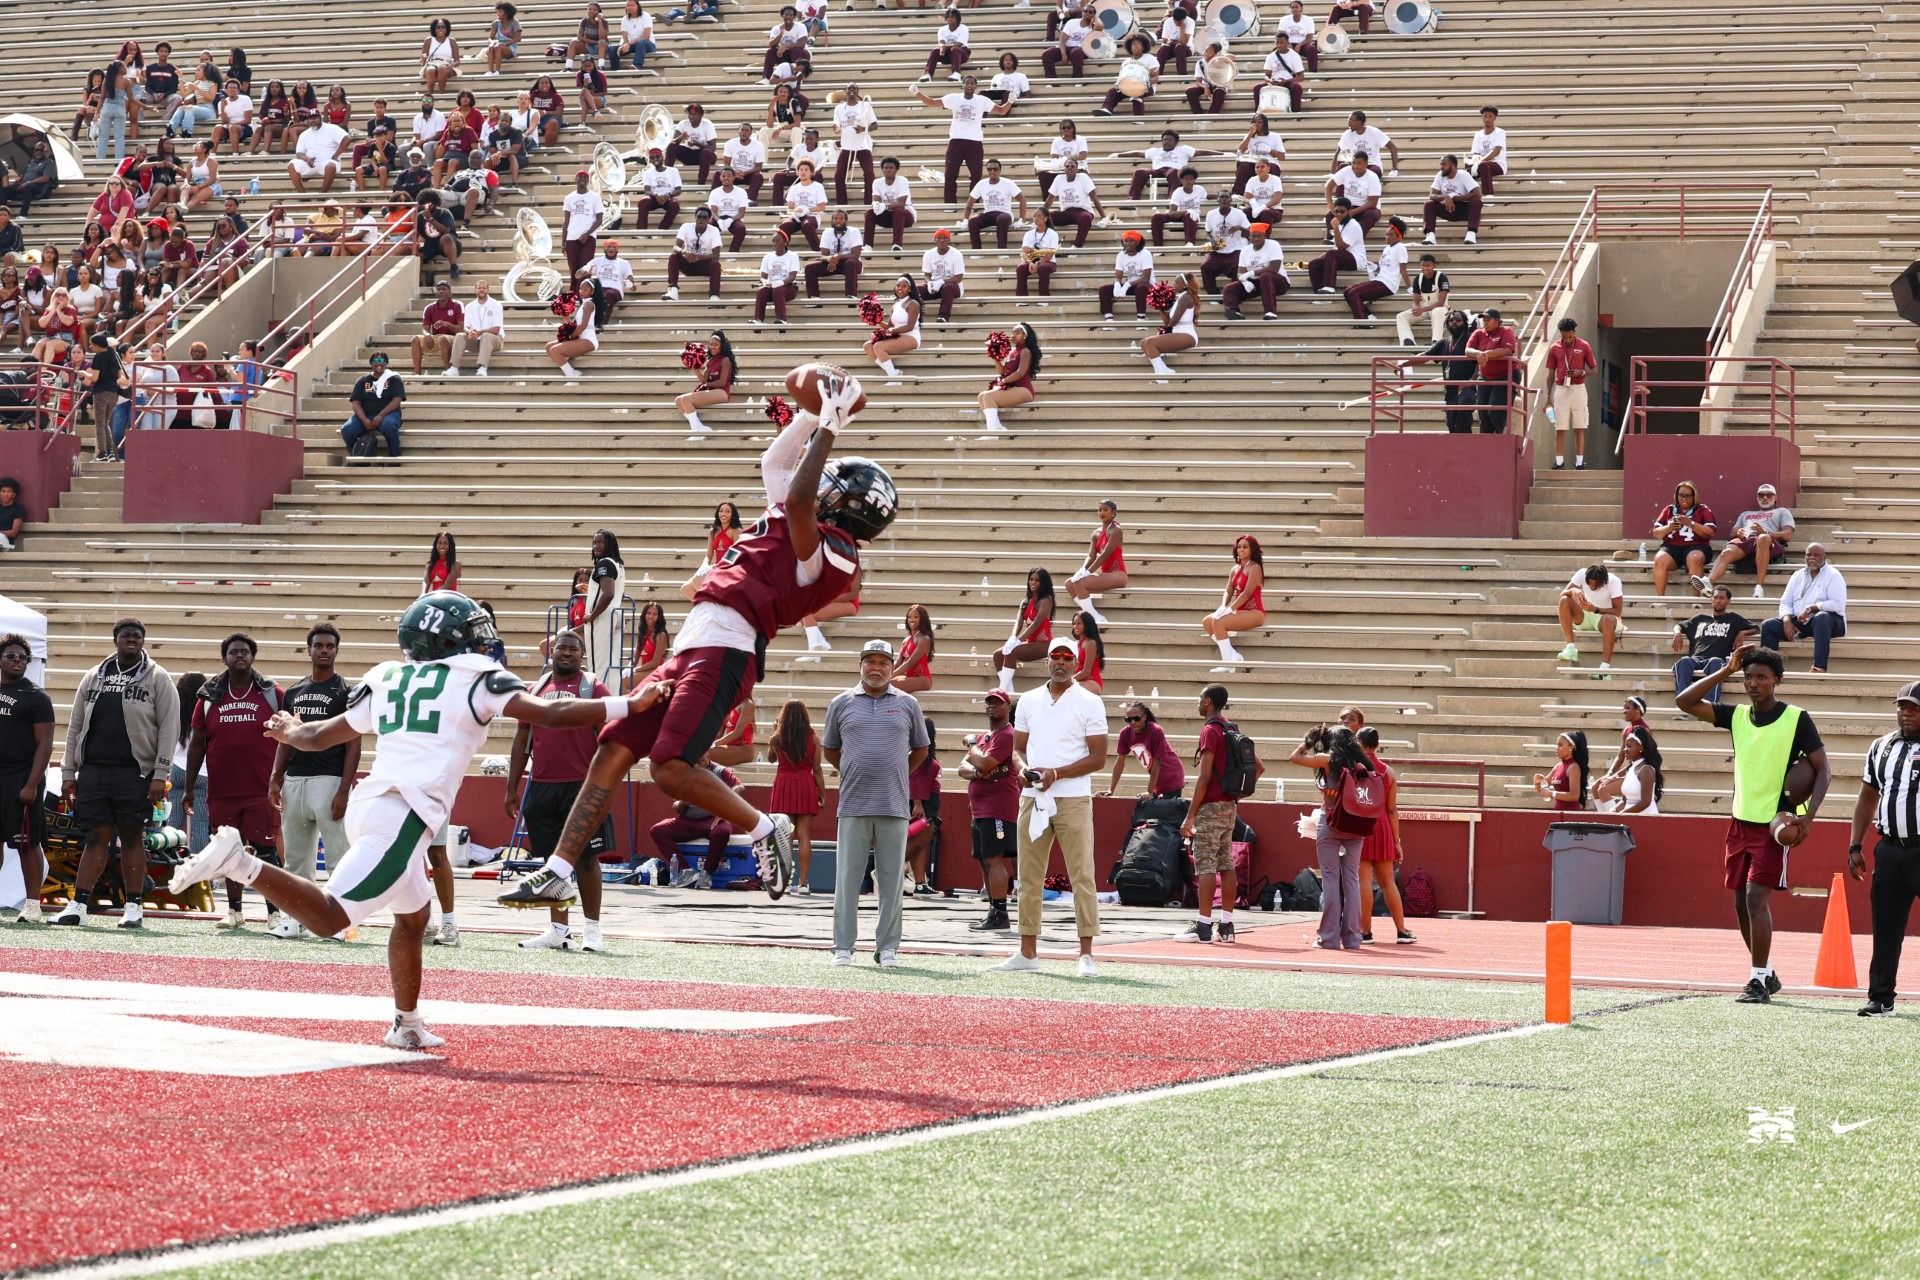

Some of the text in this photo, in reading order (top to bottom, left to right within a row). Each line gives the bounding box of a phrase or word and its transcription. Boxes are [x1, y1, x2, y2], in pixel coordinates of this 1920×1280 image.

[418, 606, 445, 634] 32
[294, 693, 333, 705] MOREHOUSE
[379, 663, 451, 735] 32
[218, 702, 259, 714] MOREHOUSE
[293, 706, 328, 715] FOOTBALL
[219, 714, 257, 723] FOOTBALL
[1910, 769, 1920, 781] F
[1430, 813, 1450, 821] RELAYS
